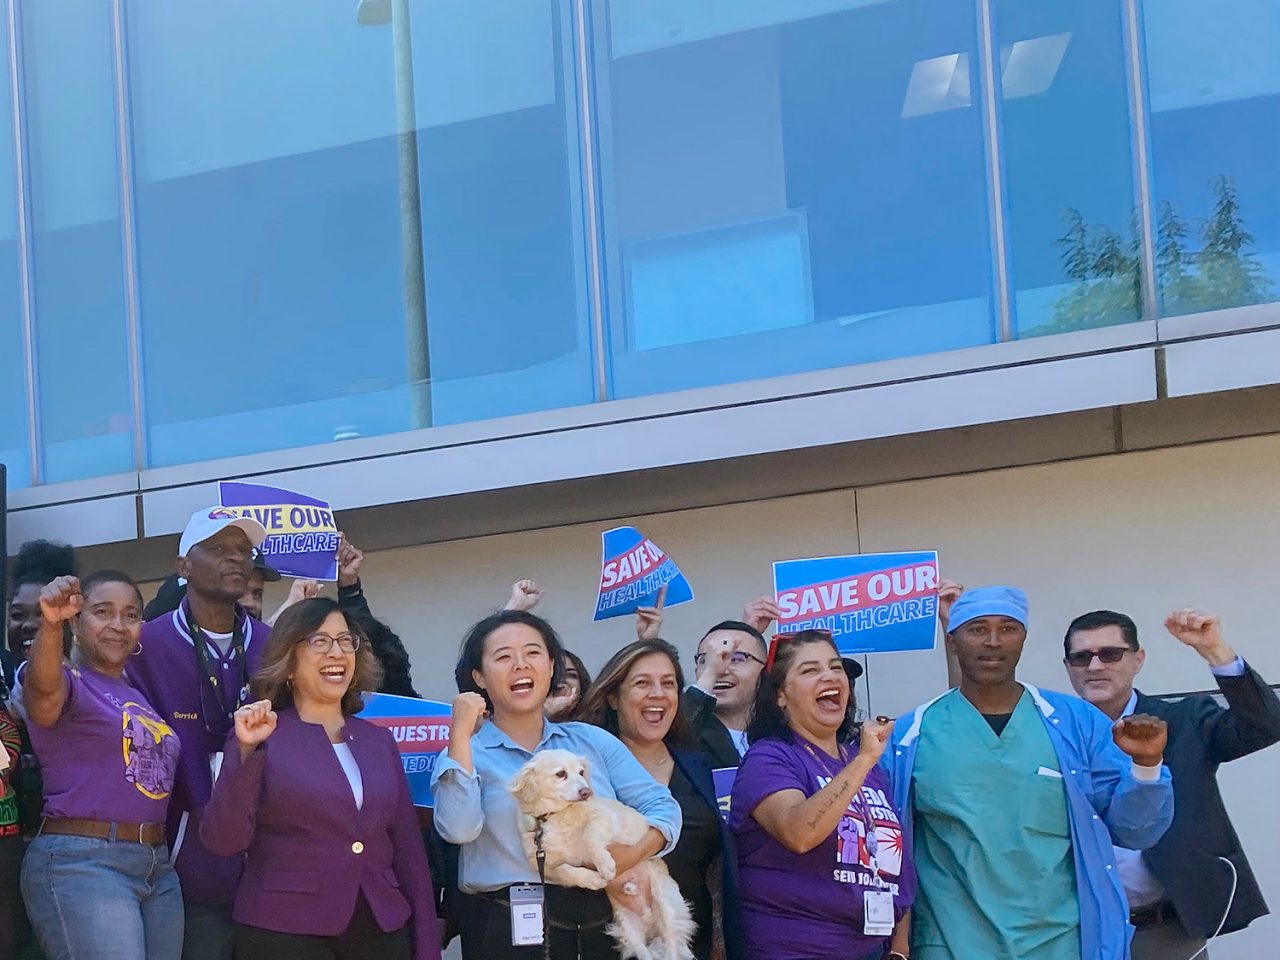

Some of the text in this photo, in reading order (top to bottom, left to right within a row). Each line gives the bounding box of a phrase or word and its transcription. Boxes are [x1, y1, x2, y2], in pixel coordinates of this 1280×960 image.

[290, 507, 335, 529] OUR
[603, 545, 651, 588] SAVE
[778, 565, 937, 619] SAVE OUR
[388, 725, 451, 743] UESTR
[832, 869, 857, 884] SEIU
